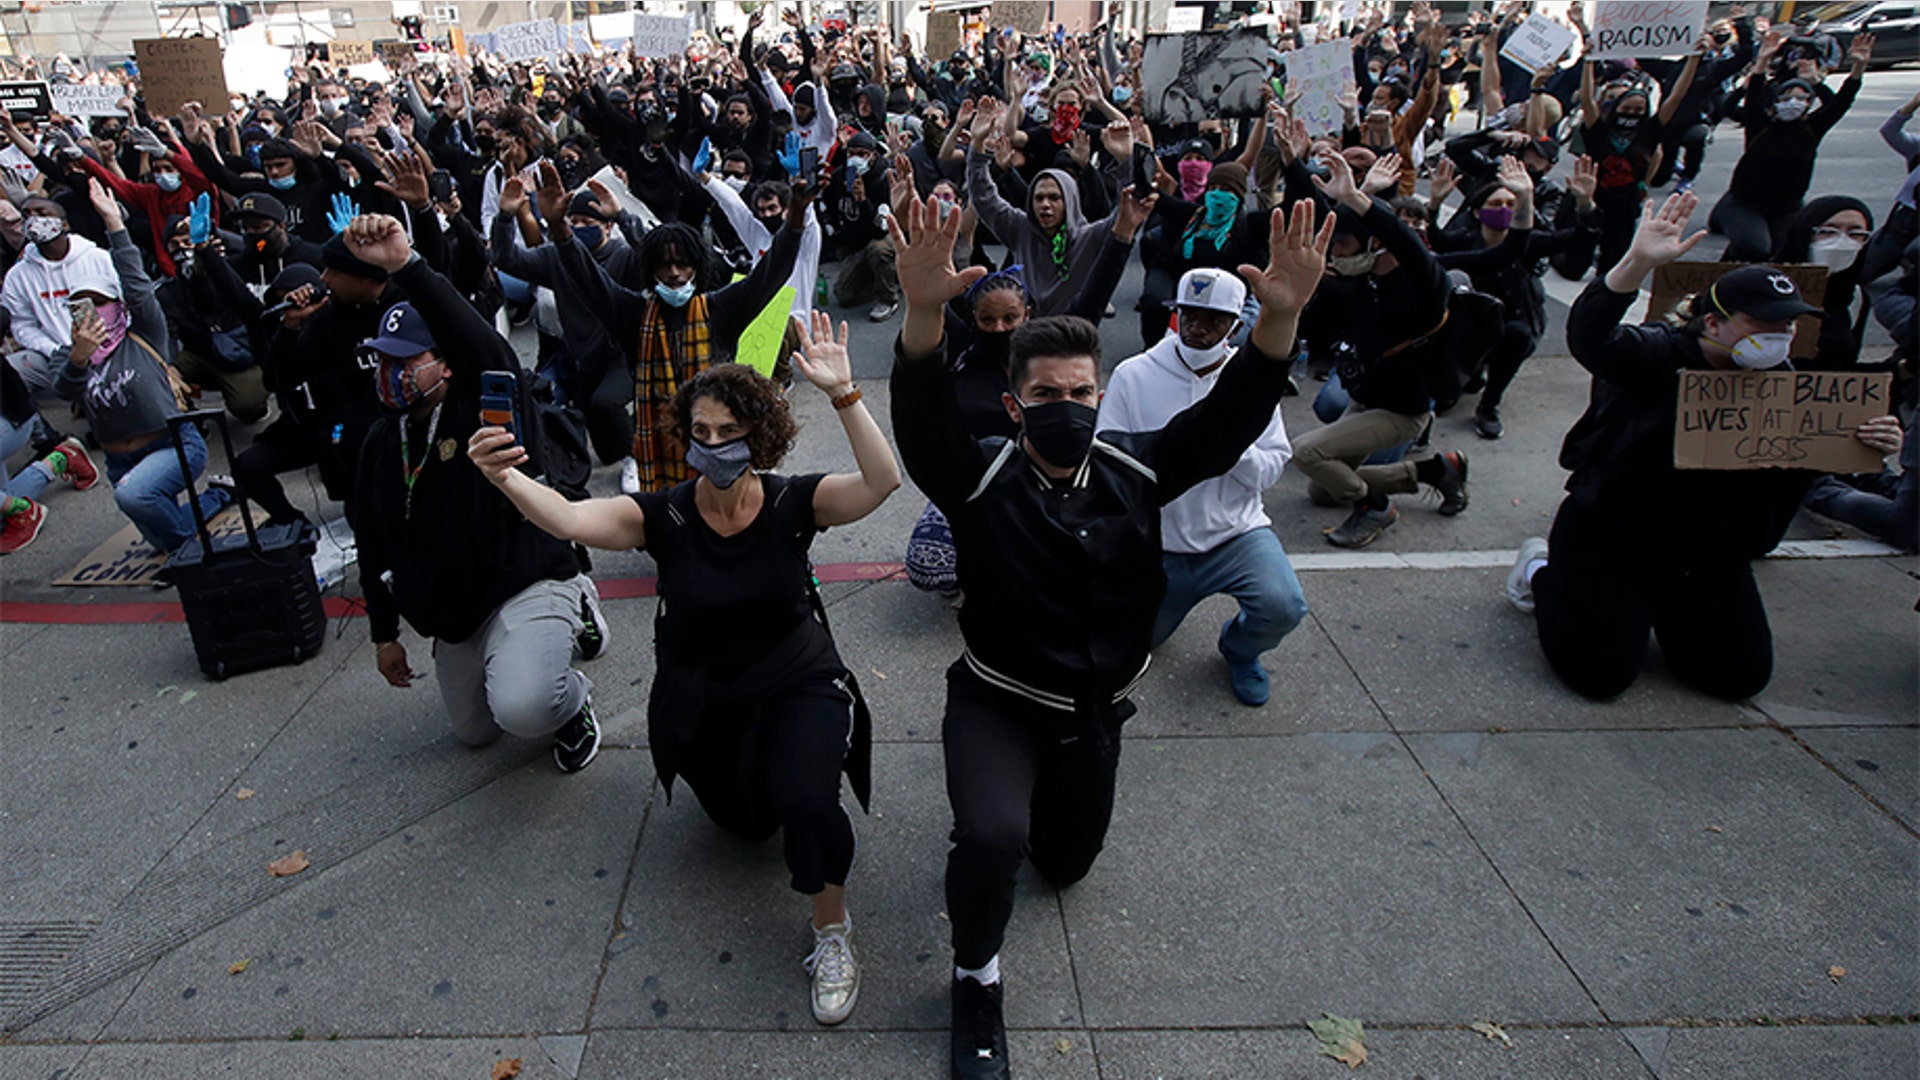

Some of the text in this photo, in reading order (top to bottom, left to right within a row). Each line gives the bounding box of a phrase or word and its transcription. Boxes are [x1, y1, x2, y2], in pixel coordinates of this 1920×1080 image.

[1599, 25, 1691, 51] RACISM
[1684, 372, 1881, 405] PROTECT BLACK
[1684, 406, 1856, 435] LIVES AT ALL
[1734, 435, 1813, 461] COSTS
